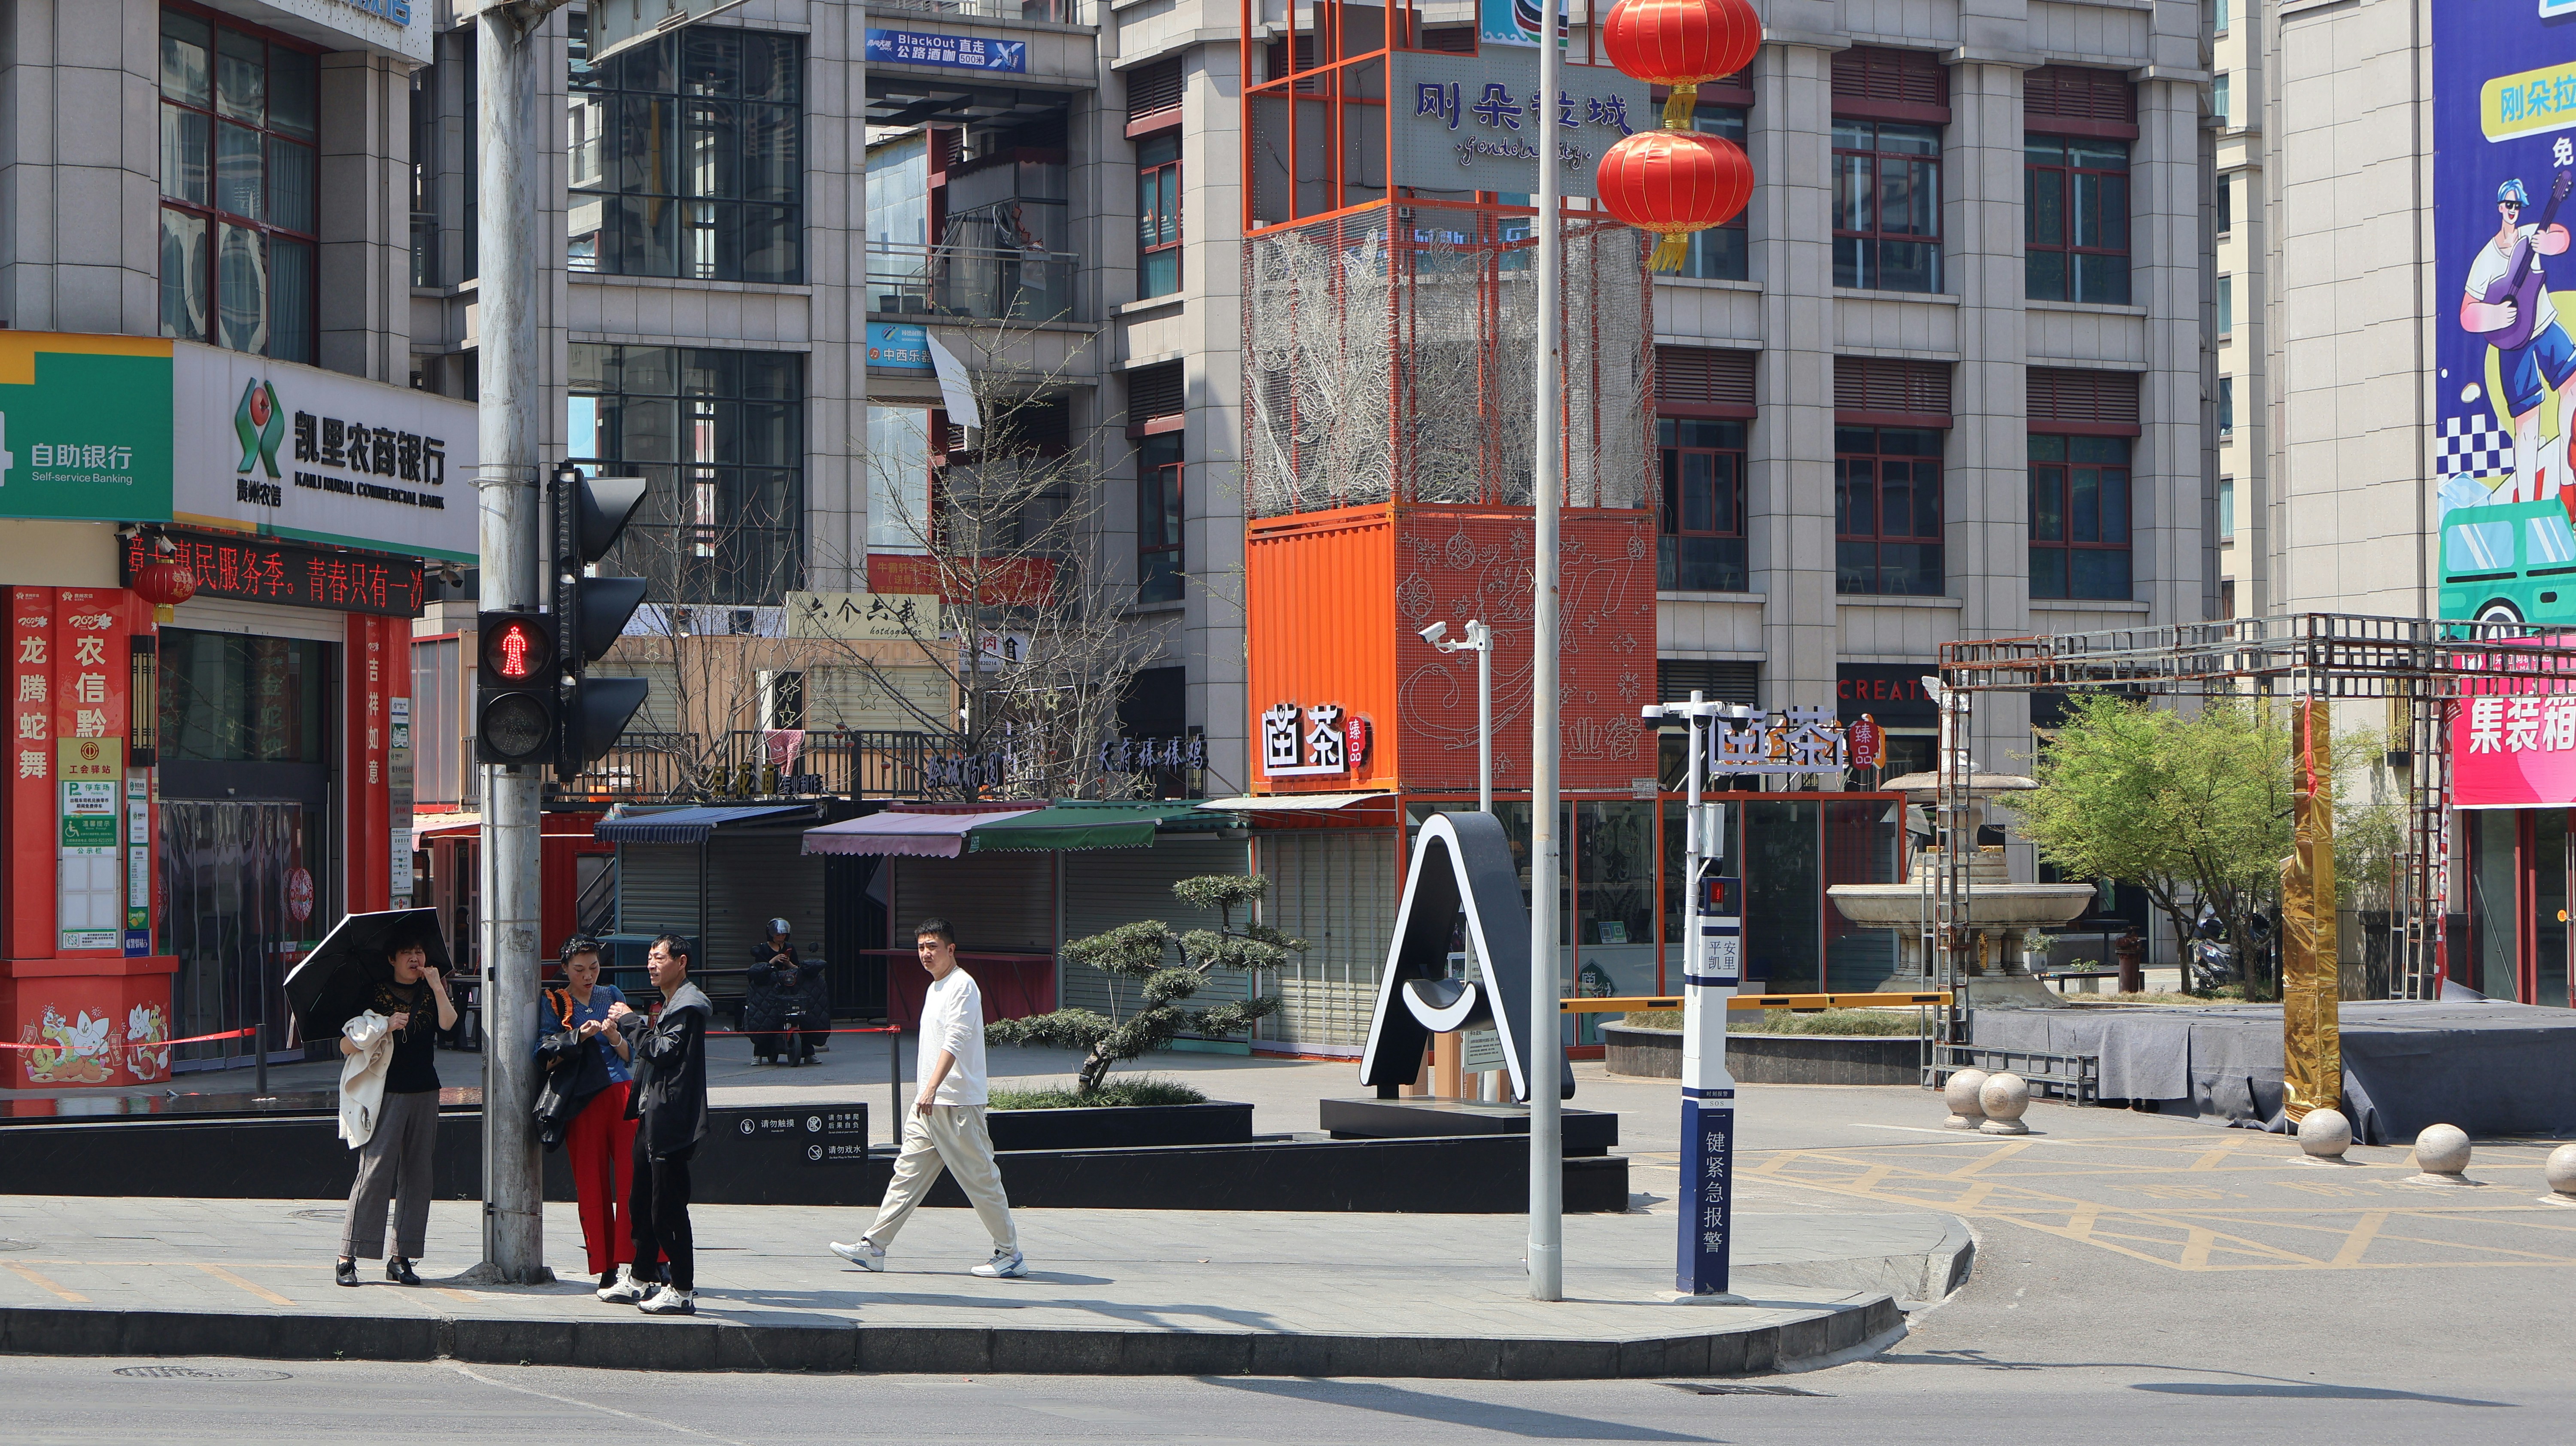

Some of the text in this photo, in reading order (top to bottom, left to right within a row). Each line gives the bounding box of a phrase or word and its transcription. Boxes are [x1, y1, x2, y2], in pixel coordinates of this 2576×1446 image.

[898, 34, 955, 49] BlackOut
[959, 39, 985, 54] 直走
[897, 45, 956, 62] 公路酒咖
[960, 55, 983, 64] 500米
[2552, 137, 2574, 168] 免
[883, 348, 932, 364] 中西乐器
[31, 443, 132, 470] 自助银行
[294, 410, 446, 485] 凯里农商银行
[32, 471, 132, 485] Self-service Banking
[237, 479, 282, 507] 贵州农信
[295, 471, 444, 510] KAILI RURAL COMMERCIAL BANK
[74, 635, 107, 738] 农信黔
[18, 636, 48, 779] 龙腾蛇舞
[368, 657, 379, 784] 吉祥如意
[1098, 733, 1205, 773] 天府棒棒鸡
[1855, 725, 1872, 765] 臻品
[69, 765, 111, 775] 工会驿站
[712, 762, 775, 796] 豆花面
[69, 782, 79, 796] P
[782, 774, 820, 795] 专业制作
[1708, 941, 1736, 955] 平安
[1708, 956, 1736, 970] 凯里
[111, 1037, 122, 1062] 新年快乐
[761, 1118, 795, 1128] 请勿触摸
[828, 1121, 860, 1130] 后果自负
[828, 1145, 861, 1154] 请勿戏水
[1703, 1114, 1726, 1254] 一键紧急报警
